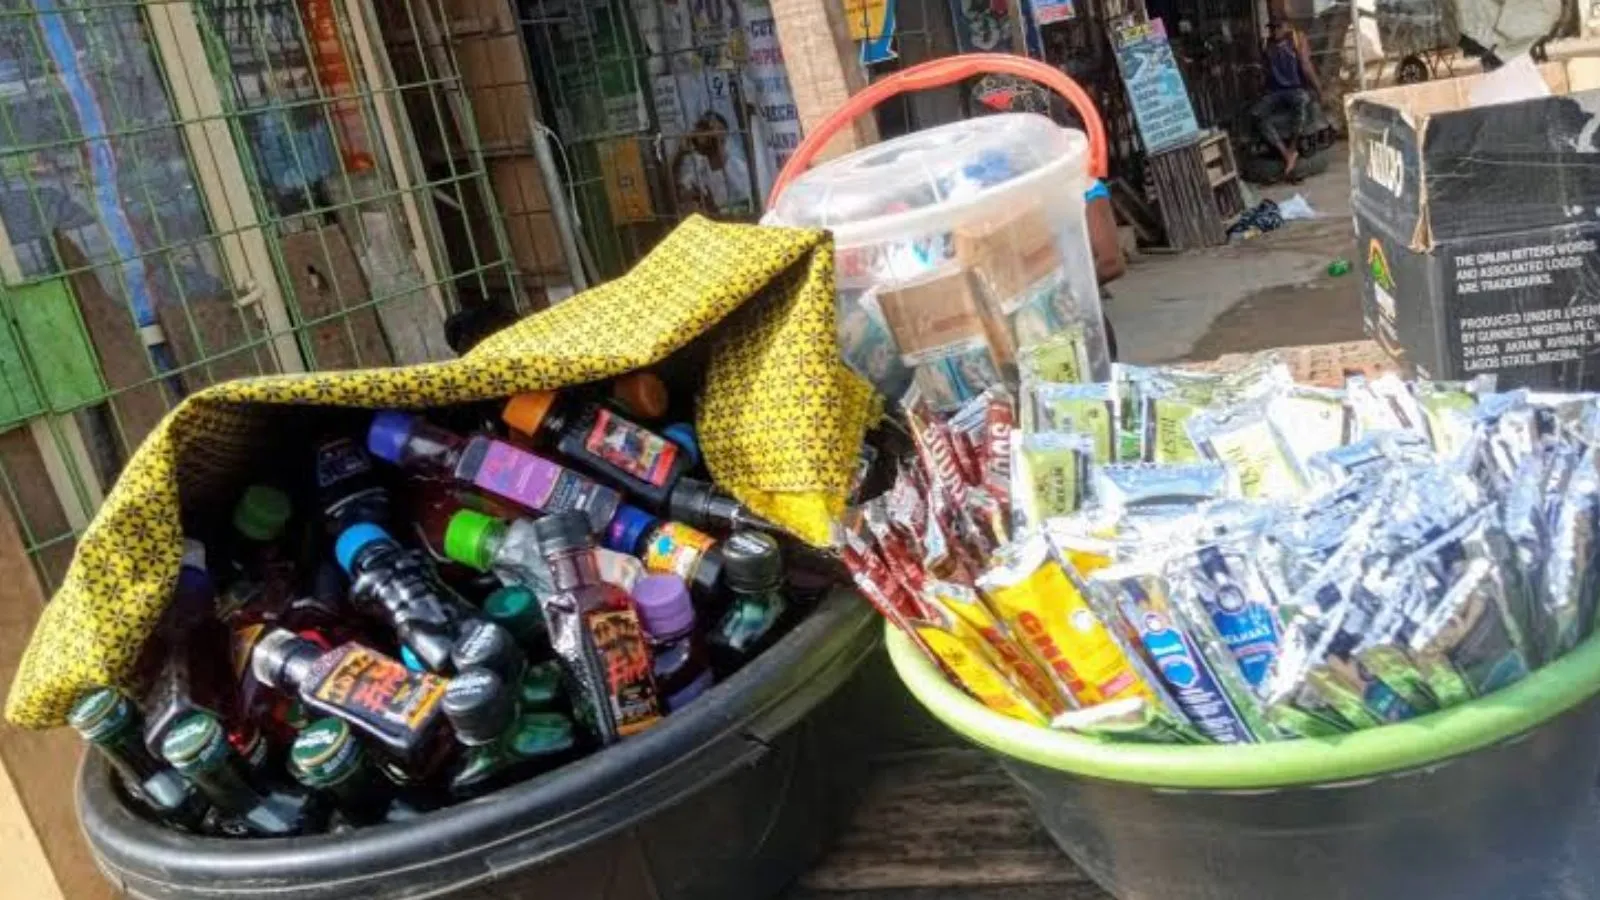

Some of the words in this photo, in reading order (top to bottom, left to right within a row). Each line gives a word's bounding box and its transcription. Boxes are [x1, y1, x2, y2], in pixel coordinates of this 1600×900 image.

[1455, 255, 1476, 267] THE
[1511, 245, 1555, 260] BITTERS
[1556, 240, 1596, 255] WORDS
[1456, 268, 1478, 280] AND
[1480, 260, 1543, 278] ASSOCIATED
[1545, 256, 1583, 271] LOGOS
[1457, 281, 1480, 294] ARE
[1460, 313, 1521, 330] PRODUCED
[1522, 309, 1561, 323] UNDER
[1564, 304, 1600, 319] LICEN
[1461, 331, 1476, 344] BY
[1476, 326, 1529, 342] GUINNESS
[1531, 321, 1573, 336] NIGERIA
[1504, 339, 1542, 353] AKRAN
[1463, 357, 1499, 371] LAGOS
